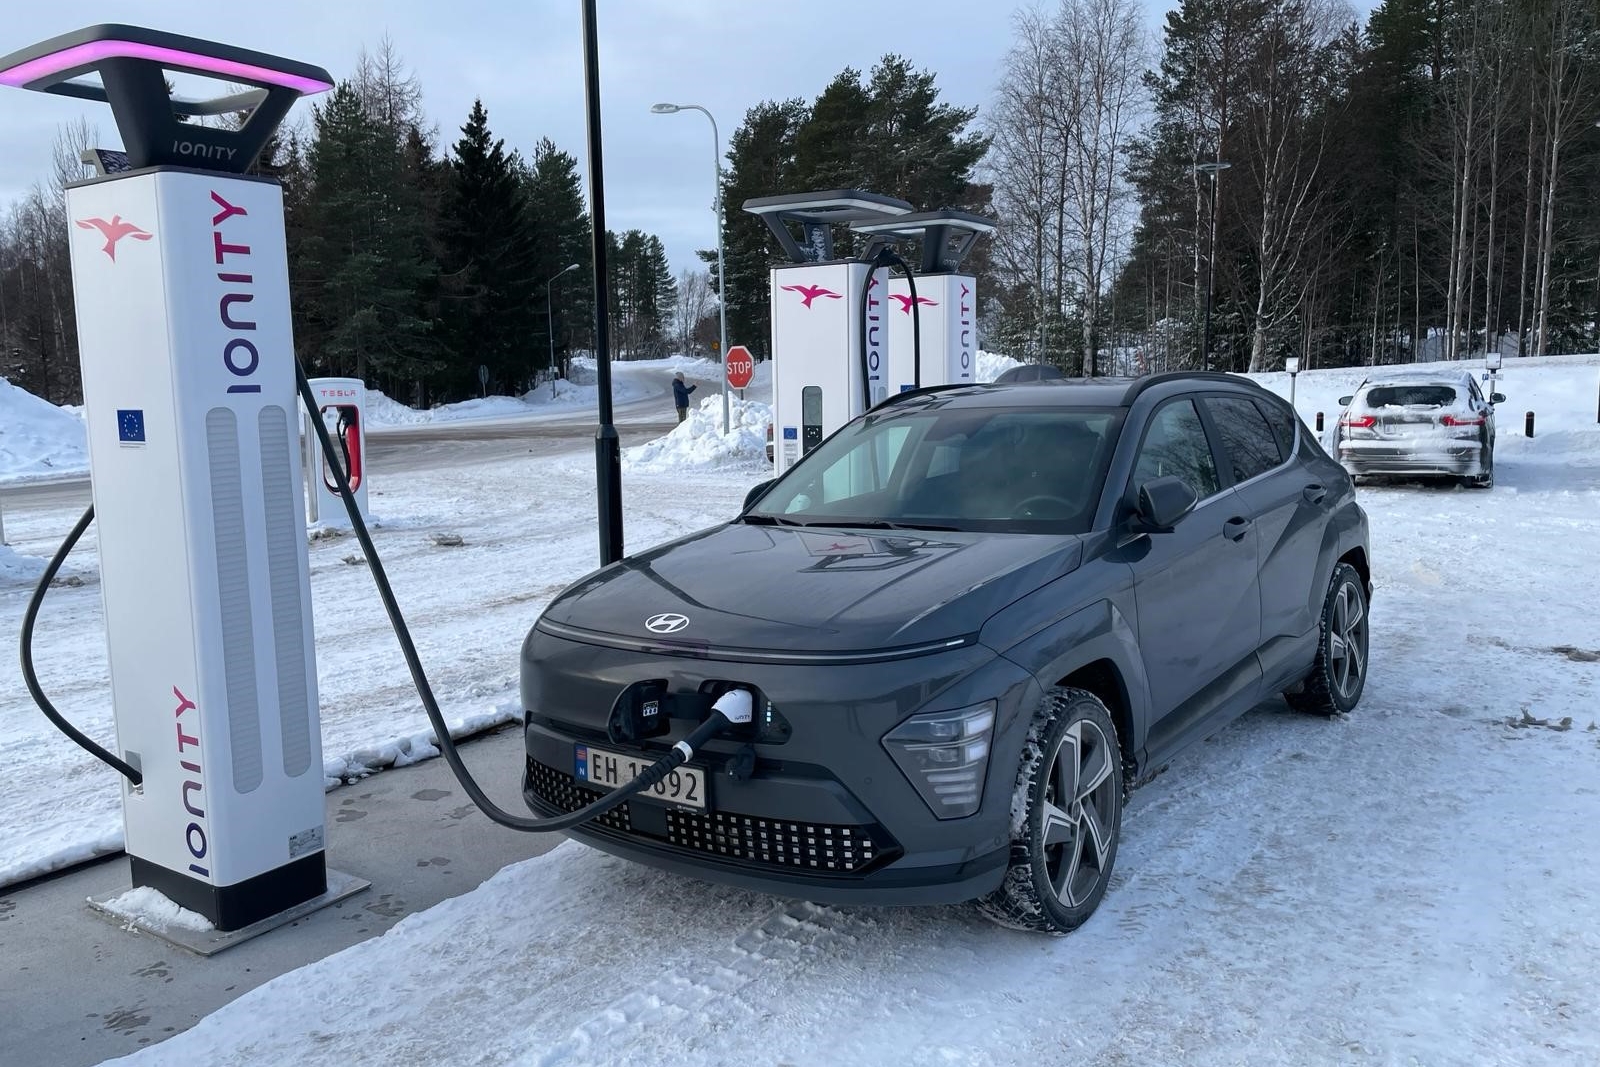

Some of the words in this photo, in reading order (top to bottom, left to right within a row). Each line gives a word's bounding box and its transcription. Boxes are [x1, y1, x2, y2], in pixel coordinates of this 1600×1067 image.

[172, 140, 238, 160] IONITY
[210, 190, 262, 393] IONITY
[868, 276, 880, 380] IONITY
[961, 283, 970, 378] IONITY
[727, 361, 751, 375] STOP
[173, 685, 210, 877] IONITY
[579, 767, 585, 776] N
[592, 753, 618, 784] EH
